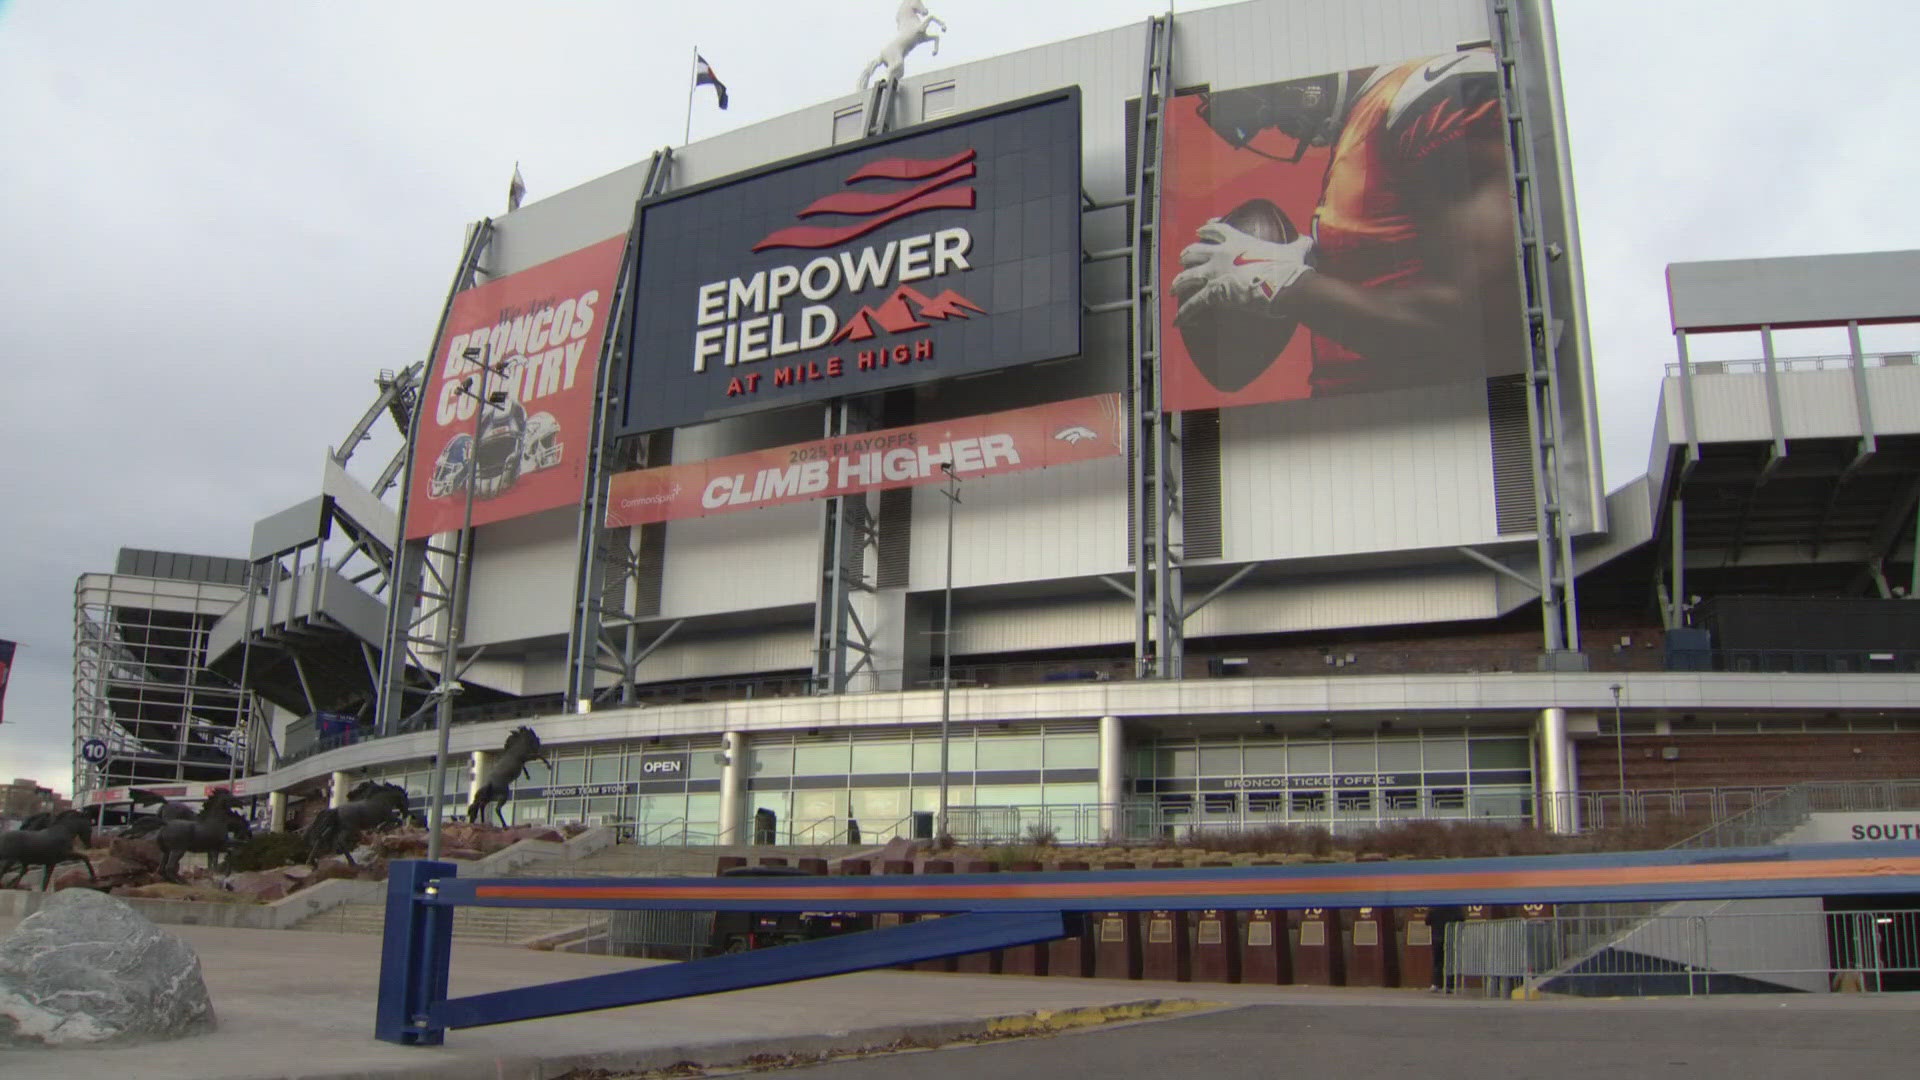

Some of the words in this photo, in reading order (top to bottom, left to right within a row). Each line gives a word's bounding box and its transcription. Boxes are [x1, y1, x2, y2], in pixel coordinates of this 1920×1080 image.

[698, 227, 974, 326] EMPOWER
[443, 289, 599, 380] BRONCOS
[694, 304, 840, 372] FIELD
[726, 373, 761, 397] AT
[774, 356, 843, 388] MILE
[857, 338, 934, 371] HIGH
[789, 446, 827, 463] 2025
[834, 432, 918, 456] PLAYOFFS
[702, 460, 830, 509] CLIMB
[837, 433, 1021, 489] HIGHER
[85, 744, 105, 758] 10
[644, 760, 681, 773] OPEN
[542, 787, 577, 797] BRONCOS
[578, 786, 600, 795] TEAM
[1224, 778, 1289, 788] BRONCOS
[1292, 776, 1341, 787] TICKET
[1344, 775, 1395, 786] OFFICE
